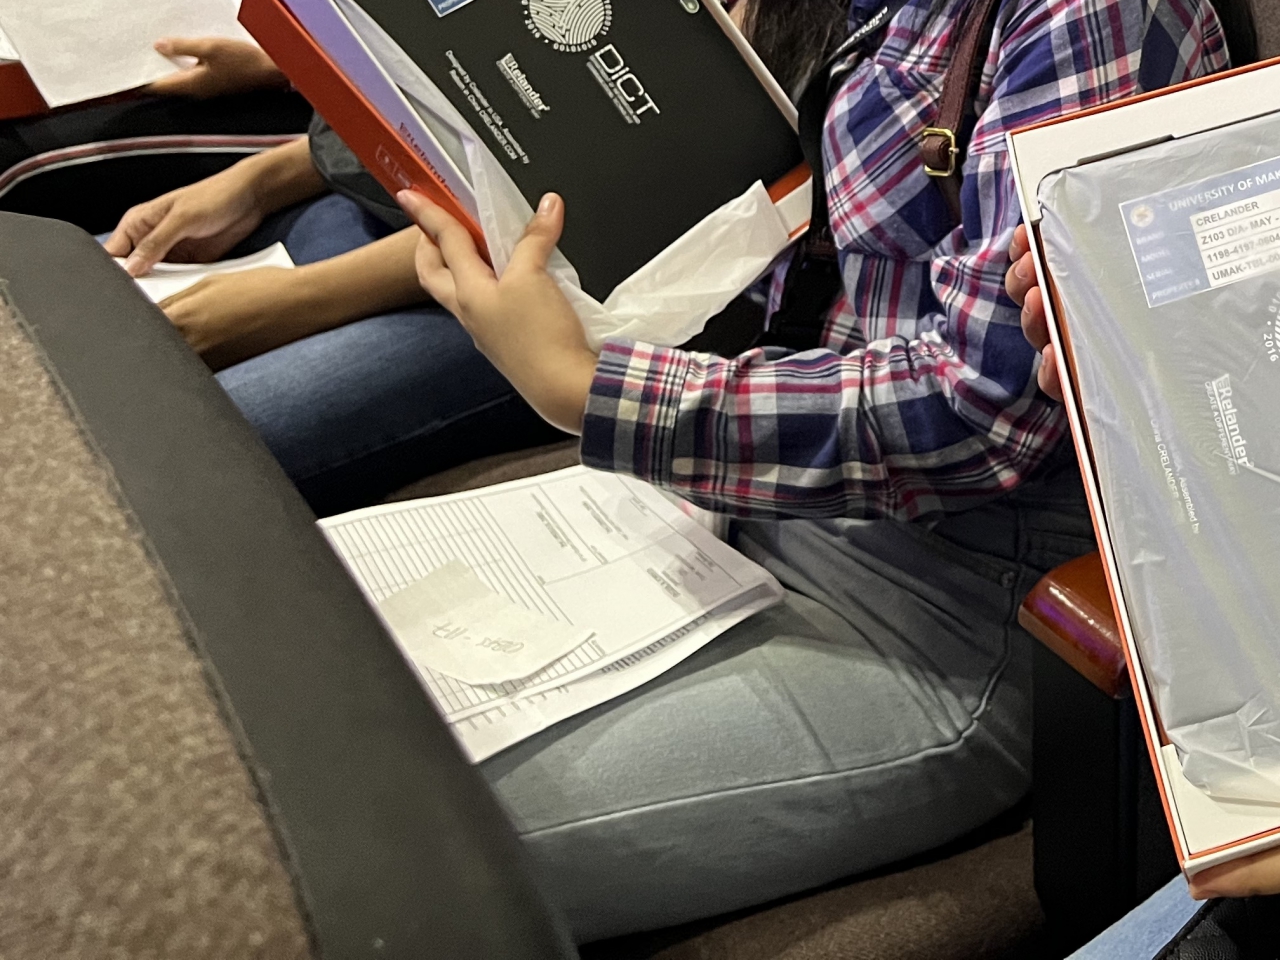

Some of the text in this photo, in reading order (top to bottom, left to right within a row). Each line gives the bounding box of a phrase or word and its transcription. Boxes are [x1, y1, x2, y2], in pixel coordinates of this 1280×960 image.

[593, 44, 660, 114] DICT
[1168, 183, 1234, 211] UNIVERSITY
[1237, 177, 1253, 190] OF
[1195, 201, 1259, 227] CRELANDER
[1200, 230, 1225, 245] Z103
[1249, 215, 1272, 230] MAY
[1263, 333, 1279, 362] 2016
[1178, 476, 1198, 522] Assembled
